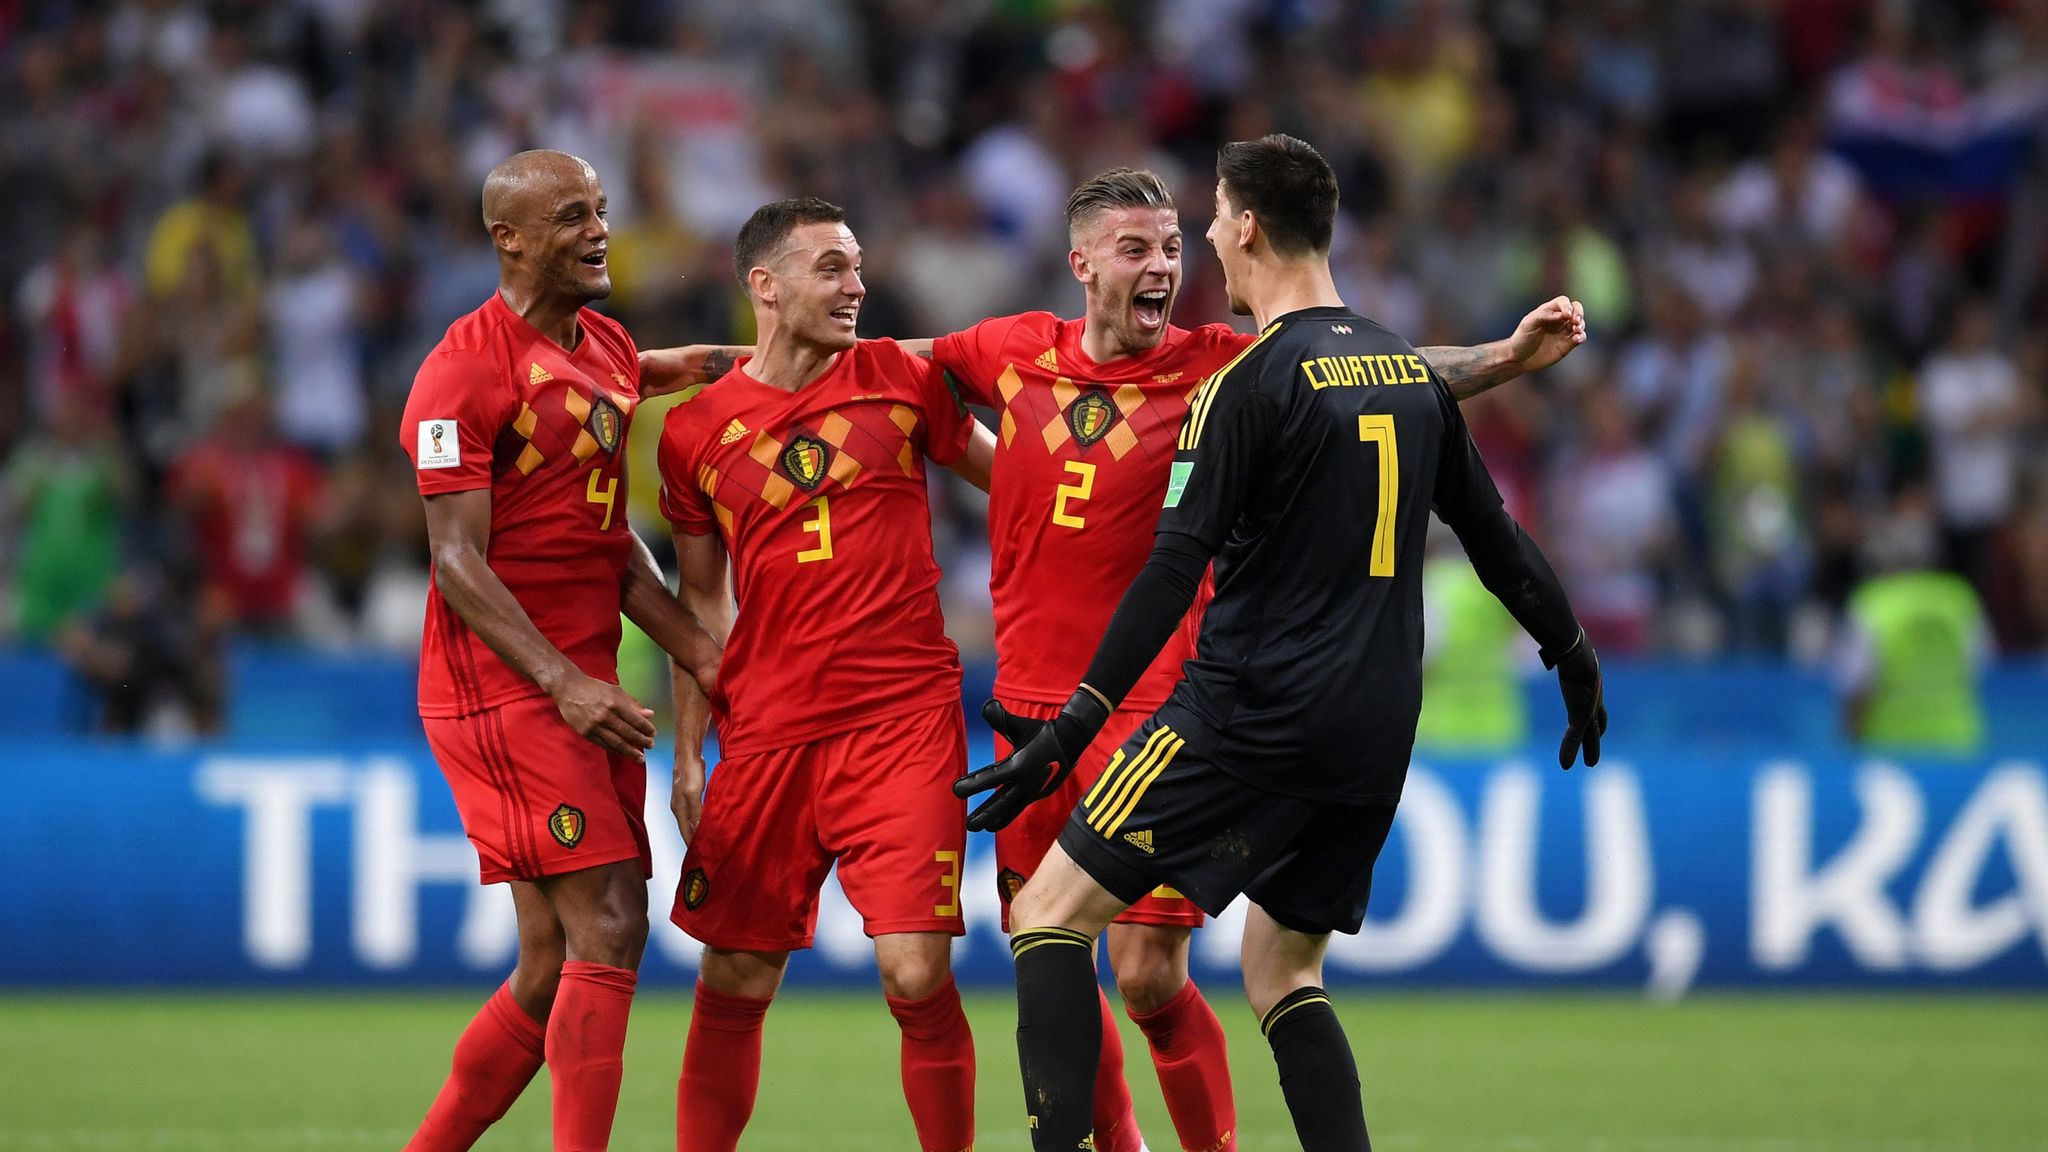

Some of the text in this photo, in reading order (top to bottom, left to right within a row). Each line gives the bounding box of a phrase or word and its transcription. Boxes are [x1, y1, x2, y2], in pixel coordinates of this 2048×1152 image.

[1035, 358, 1060, 373] adidas
[1301, 354, 1429, 391] COURTOIS
[587, 469, 618, 530] 4
[1052, 460, 1096, 529] 2
[1358, 414, 1399, 577] 1
[797, 495, 833, 563] 3
[1124, 832, 1155, 855] adidas
[934, 850, 958, 917] 3
[1200, 760, 1706, 1003] OU,
